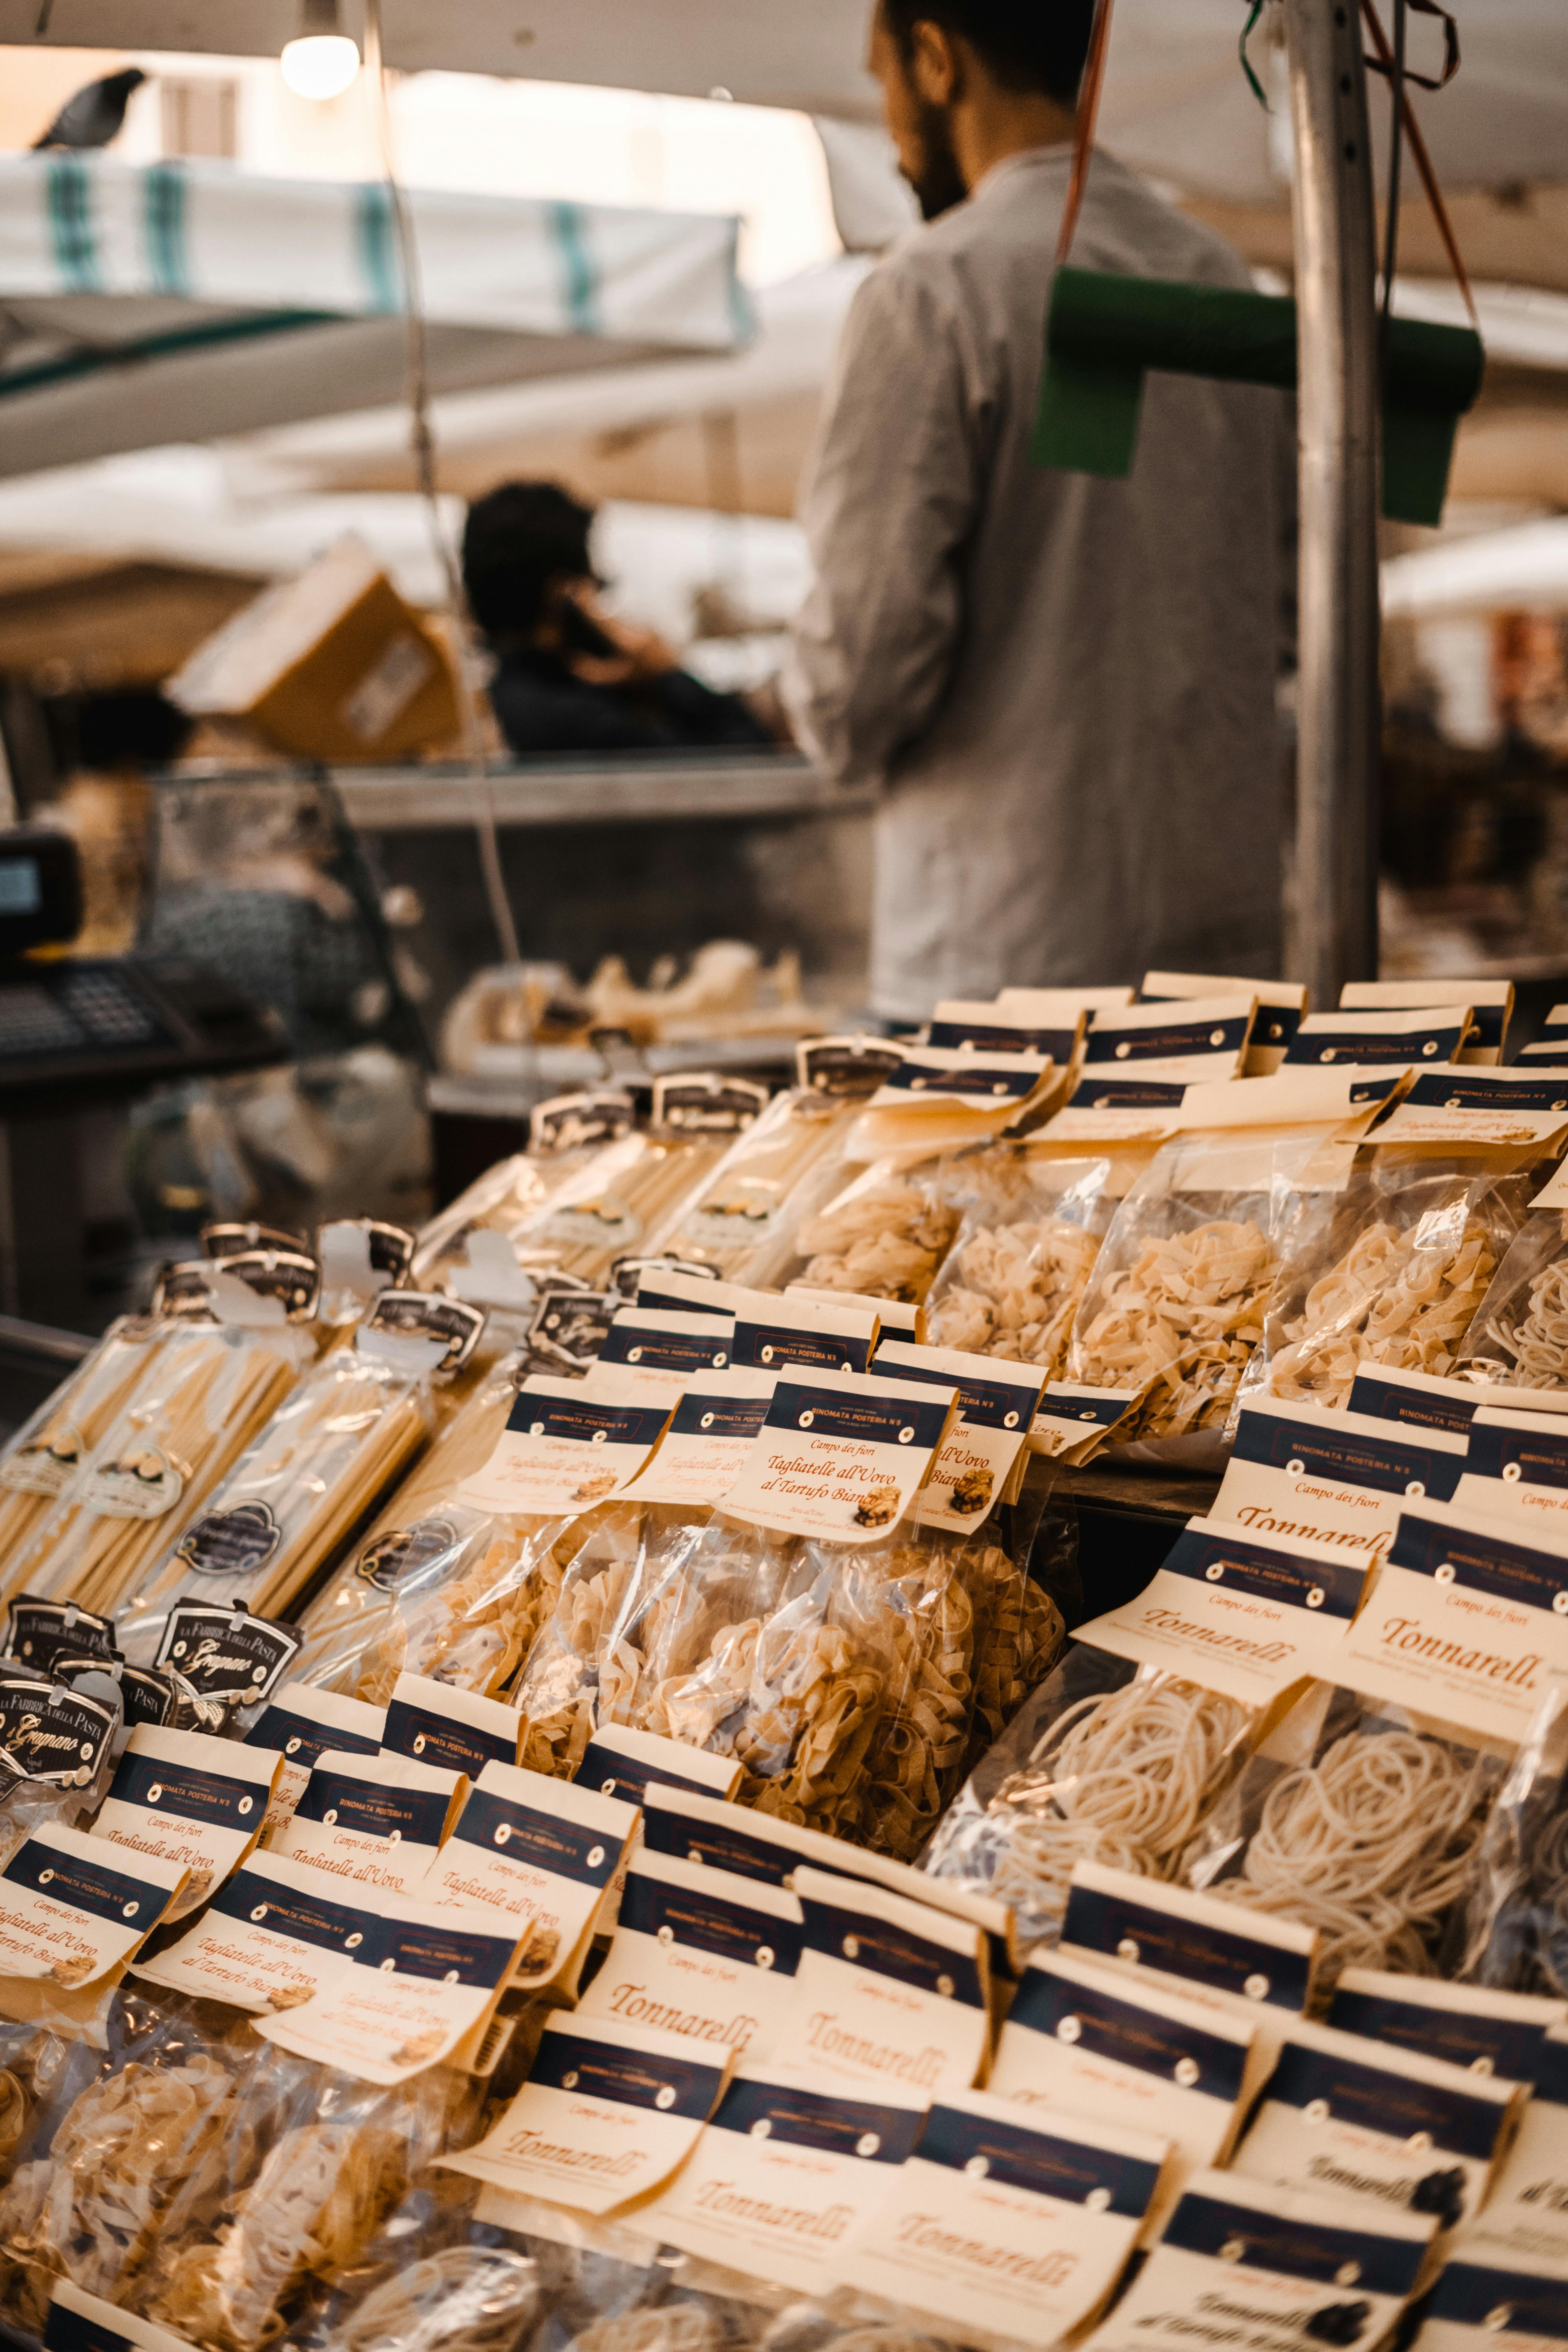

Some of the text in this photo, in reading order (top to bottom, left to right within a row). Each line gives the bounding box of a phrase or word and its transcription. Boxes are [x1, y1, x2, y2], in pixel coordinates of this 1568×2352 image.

[798, 1348, 825, 1359] POSTERIA
[549, 1414, 583, 1423] RINOMATA
[585, 1419, 615, 1428] POSTERIA
[812, 1408, 849, 1419] RINOMATA
[852, 1414, 887, 1424] POSTERIA
[1399, 1408, 1445, 1426] RINOMATA
[947, 1426, 971, 1438] fiori
[811, 1440, 877, 1456] Campo dei fiori
[1292, 1443, 1342, 1461] RINOMATA
[1346, 1454, 1390, 1472] POSTERIA
[666, 1456, 722, 1472] Tagliatelle
[768, 1455, 836, 1476] Tagliatelle
[760, 1477, 878, 1505] al Tartufo Bianco
[1295, 1482, 1382, 1509] Campo dei fiori
[1522, 1493, 1558, 1510] Campo
[1208, 1594, 1284, 1621] Campo dei fiori
[191, 1621, 232, 1641] FABBRICA
[249, 1637, 278, 1663] PASTA
[1140, 1609, 1296, 1662] Tonnarelli
[181, 1638, 253, 1677] Gragnano
[134, 1687, 158, 1713] PASTA
[10, 1694, 51, 1716] FABBRICA
[51, 1708, 73, 1724] DELLA
[74, 1712, 101, 1740] PASTA
[5, 1714, 79, 1755] Gragnano
[447, 1742, 472, 1757] POSTERIA
[188, 1791, 217, 1804] POSTERIA
[339, 1798, 373, 1812] RINOMATA
[375, 1807, 402, 1818] POSTERIA
[147, 1816, 205, 1837] Campo dei fiori
[108, 1830, 166, 1857] Tagliatelle
[334, 1833, 390, 1855] Campo dei fiori
[293, 1849, 354, 1876] Tagliatelle
[489, 1860, 549, 1888] Campo dei fiori
[81, 1883, 111, 1899] POSTERIA
[442, 1871, 507, 1906] Tagliatelle
[34, 1900, 93, 1926] Campo dei fiori
[299, 1916, 332, 1930] POSTERIA
[0, 1931, 35, 1953] artufo
[197, 1937, 264, 1967] Tagliatelle
[247, 1931, 310, 1956] Campo dei fiori
[182, 1957, 206, 1967] al
[197, 1960, 248, 1983] Tartufo
[608, 1983, 759, 2052] Tonnarelli
[808, 2011, 946, 2087] Tonnarelli
[504, 2129, 649, 2177] Tonnarelli
